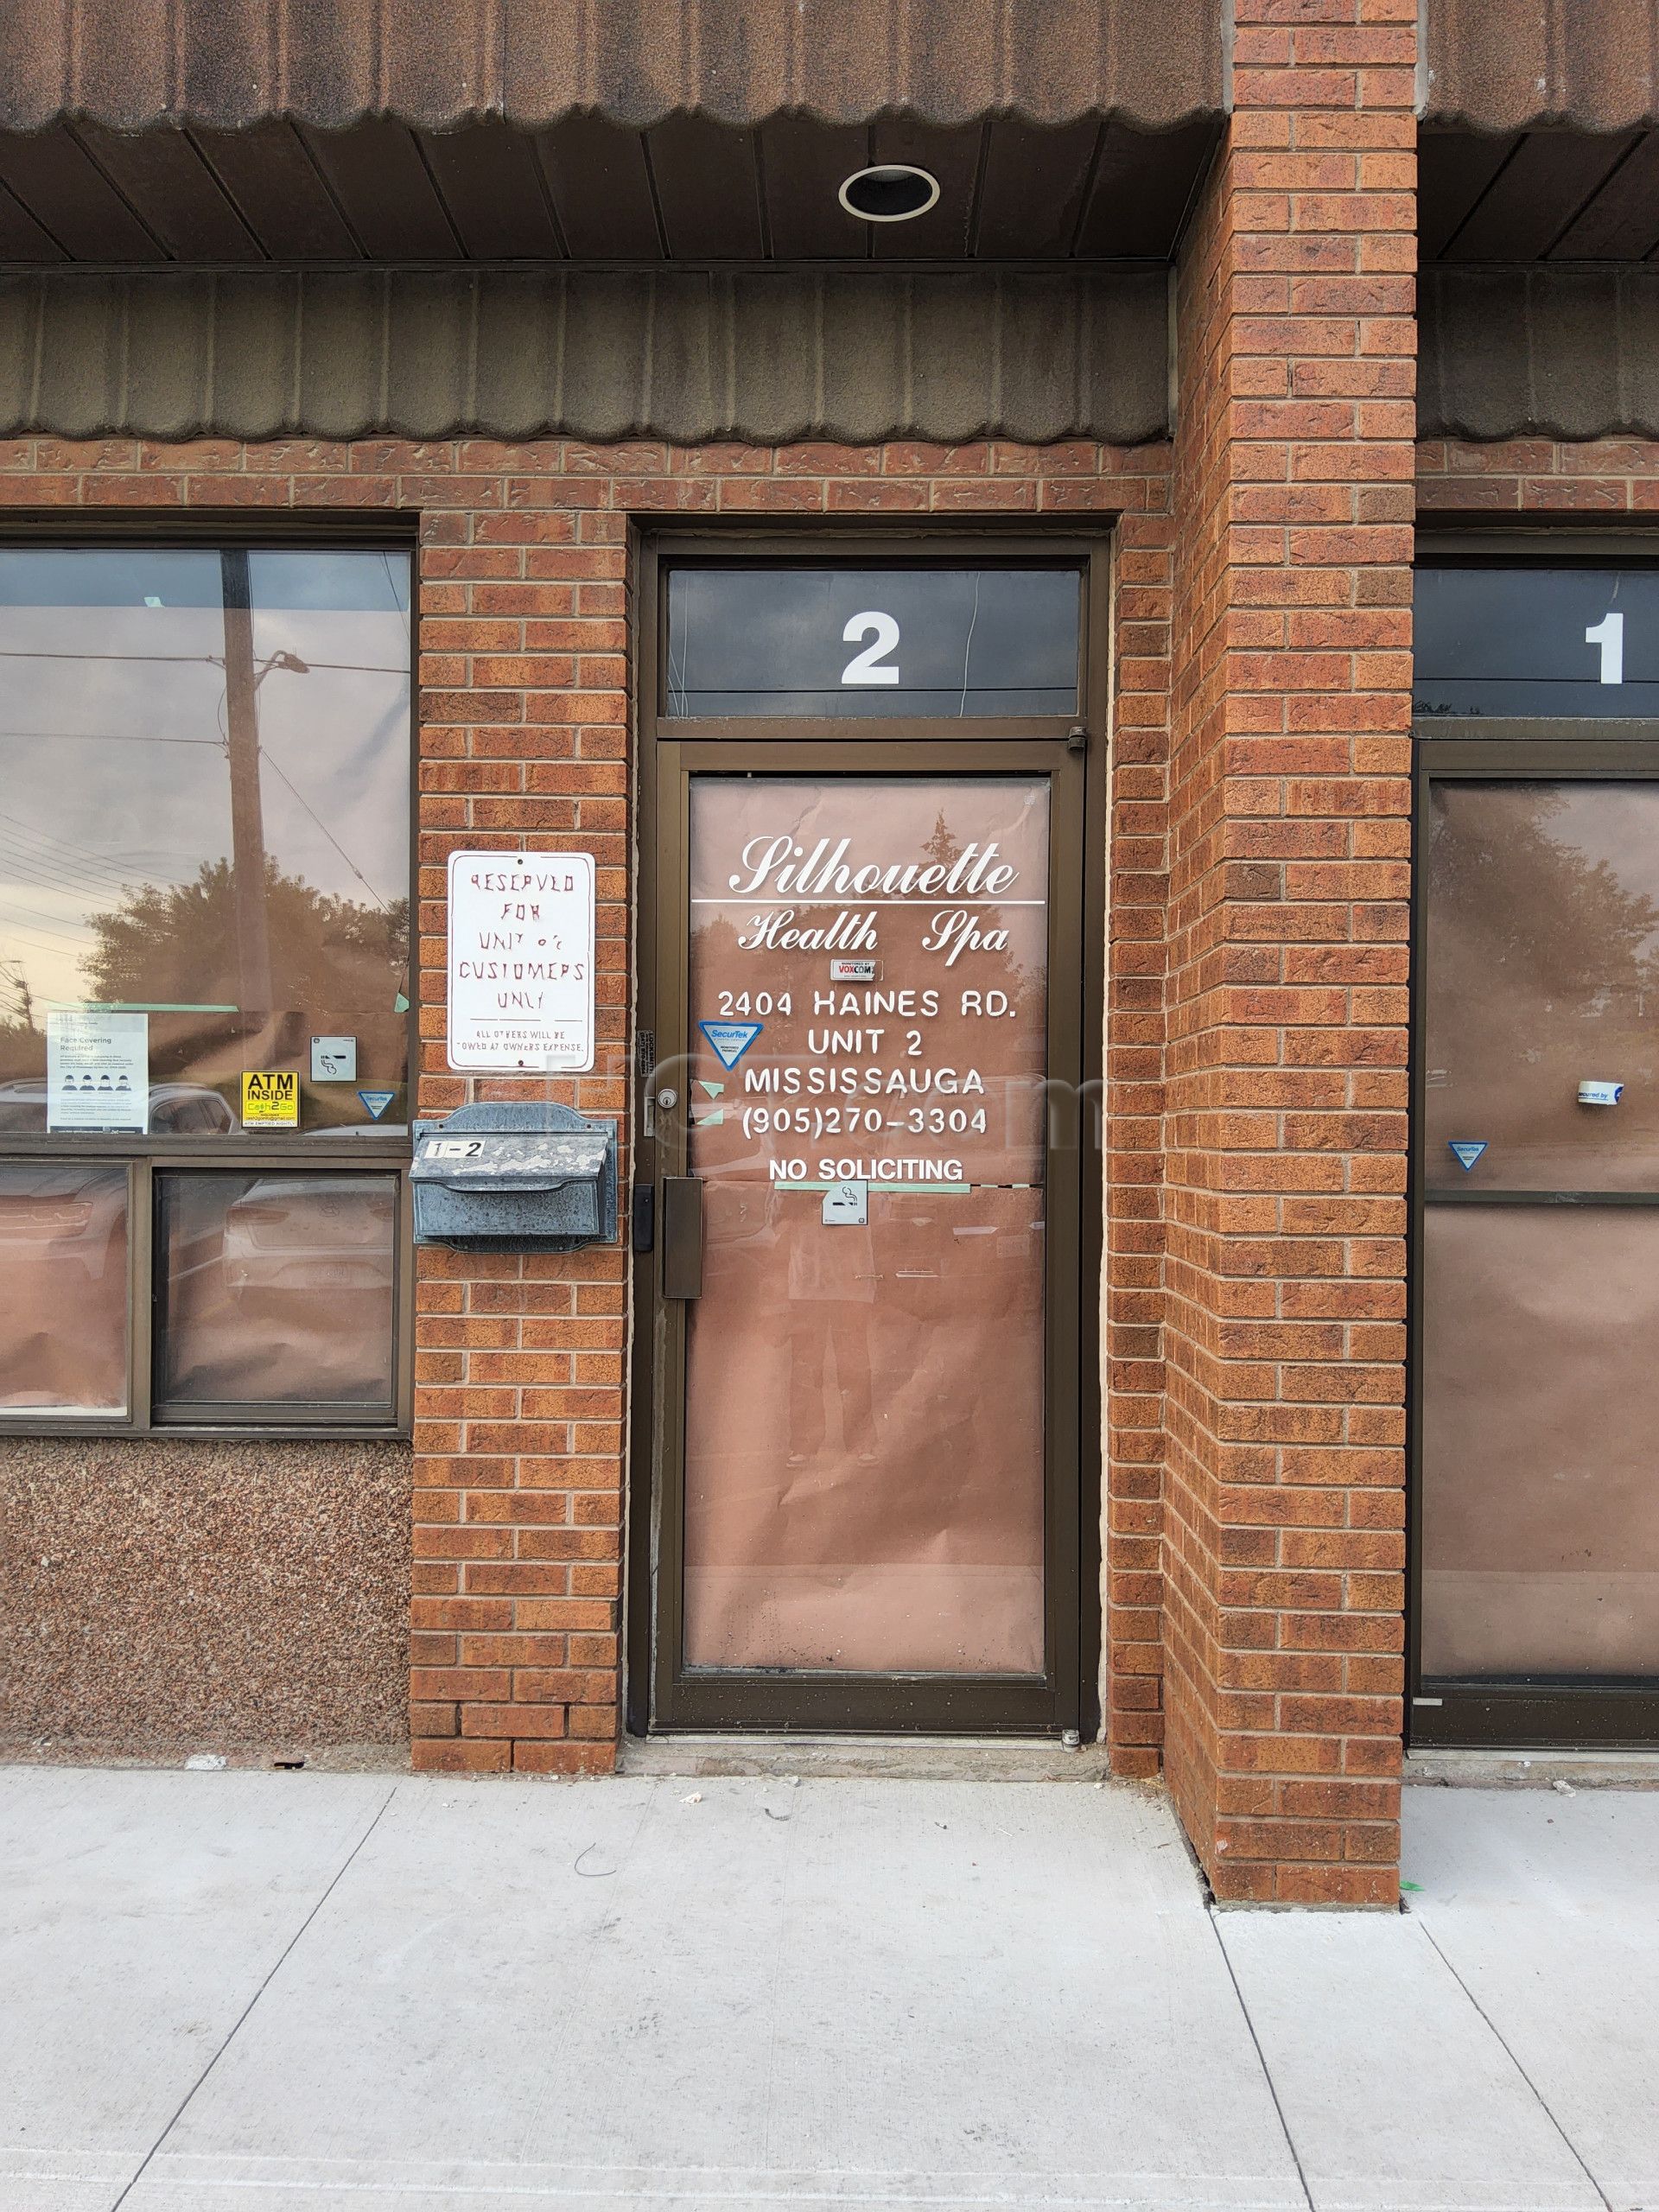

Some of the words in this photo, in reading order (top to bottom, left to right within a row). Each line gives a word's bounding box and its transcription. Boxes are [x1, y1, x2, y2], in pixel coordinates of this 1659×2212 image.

[842, 611, 899, 684] 2
[1586, 613, 1624, 684] 1
[728, 836, 1020, 894] Silhouette
[738, 910, 878, 950] Health
[921, 910, 1010, 967] Spa
[838, 965, 871, 974] VOXCOM
[718, 991, 791, 1017] 2404
[814, 990, 940, 1017] HAINES
[961, 990, 1016, 1018] RD.
[456, 1042, 486, 1051] OWED
[530, 1031, 551, 1040] WILL
[711, 1029, 748, 1039] SecurTek
[808, 1028, 885, 1055] UNIT
[906, 1030, 923, 1056] 2
[247, 1074, 294, 1090] ATM
[247, 1090, 293, 1100] INSIDE
[745, 1067, 985, 1095] MISSISSAUGA
[742, 1107, 987, 1140] (905)270-3304
[769, 1159, 807, 1180] NO
[818, 1159, 963, 1180] SOLICITING
